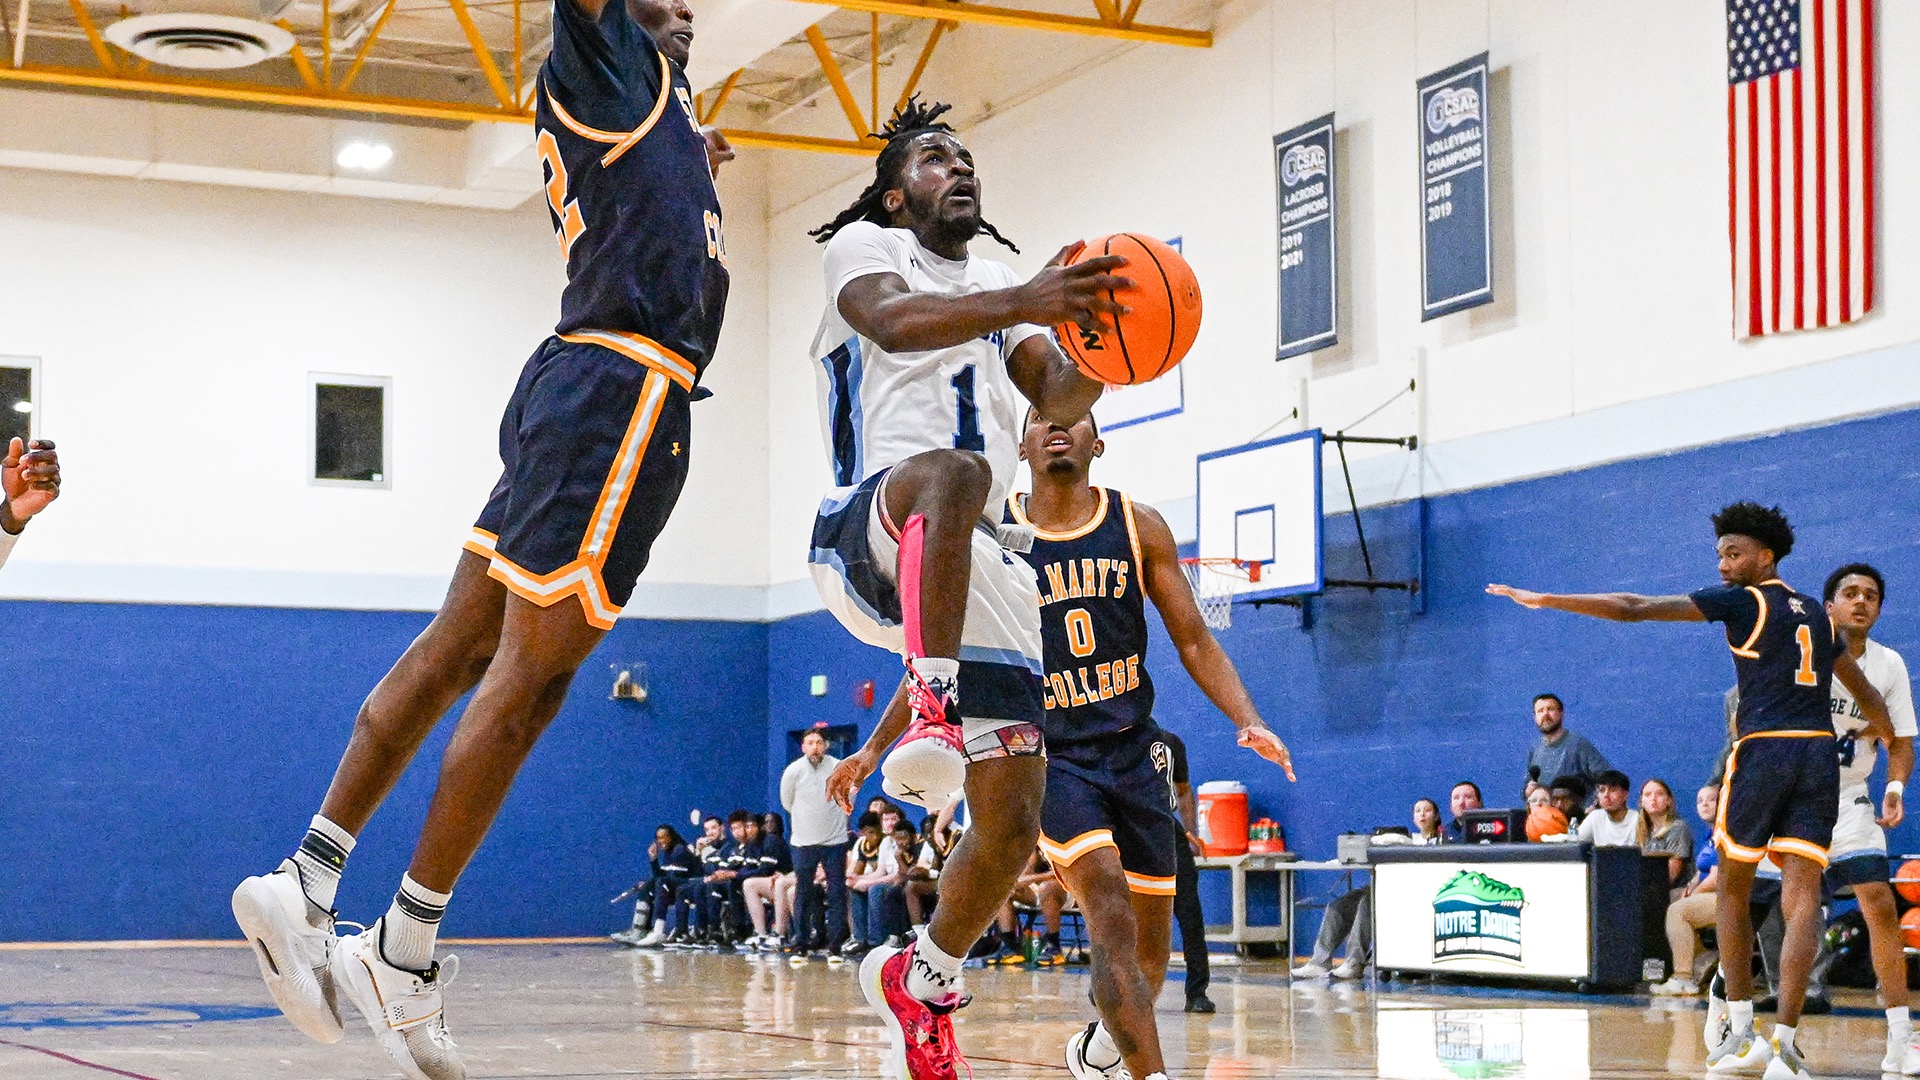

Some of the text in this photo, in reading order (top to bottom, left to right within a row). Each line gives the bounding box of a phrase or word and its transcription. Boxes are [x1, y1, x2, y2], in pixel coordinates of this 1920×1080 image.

[1444, 94, 1480, 117] CSAC
[1426, 126, 1482, 156] VOLLEYBALL
[1427, 142, 1481, 174] CHAMPIONS
[1285, 182, 1324, 206] LACROSSE
[1427, 181, 1451, 203] 2018
[1281, 196, 1329, 224] CHAMPIONS
[1427, 201, 1452, 222] 2019
[1281, 232, 1303, 251] 2019
[950, 363, 985, 454] 1
[1037, 558, 1128, 607] .MARY'S
[1064, 607, 1096, 658] 0
[1795, 624, 1818, 686] 1
[1435, 909, 1521, 942] NOTRE DAME
